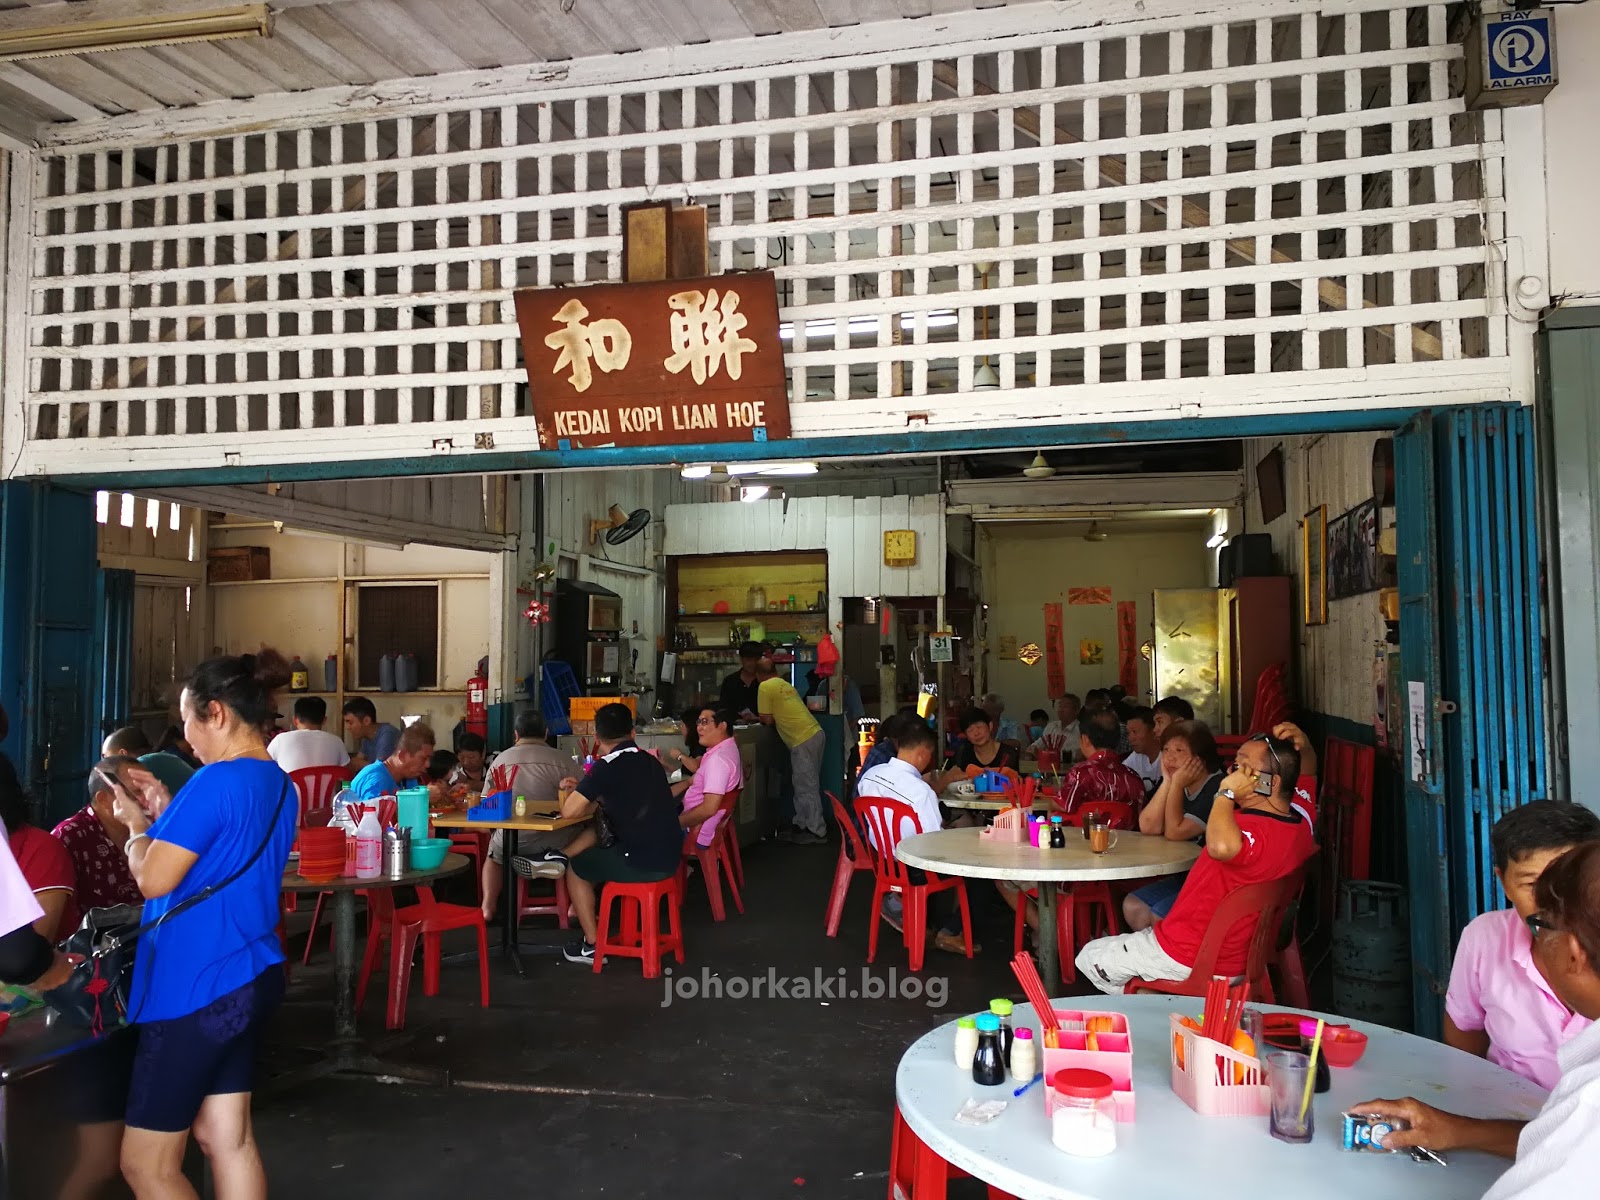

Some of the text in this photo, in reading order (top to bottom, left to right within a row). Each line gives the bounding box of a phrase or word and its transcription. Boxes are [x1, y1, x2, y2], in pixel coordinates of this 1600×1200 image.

[1500, 10, 1532, 22] RAY
[1491, 75, 1552, 89] ALARM
[554, 401, 766, 436] KEDAI KOPI LIAN HOE
[475, 433, 494, 450] 28
[934, 637, 947, 648] 31
